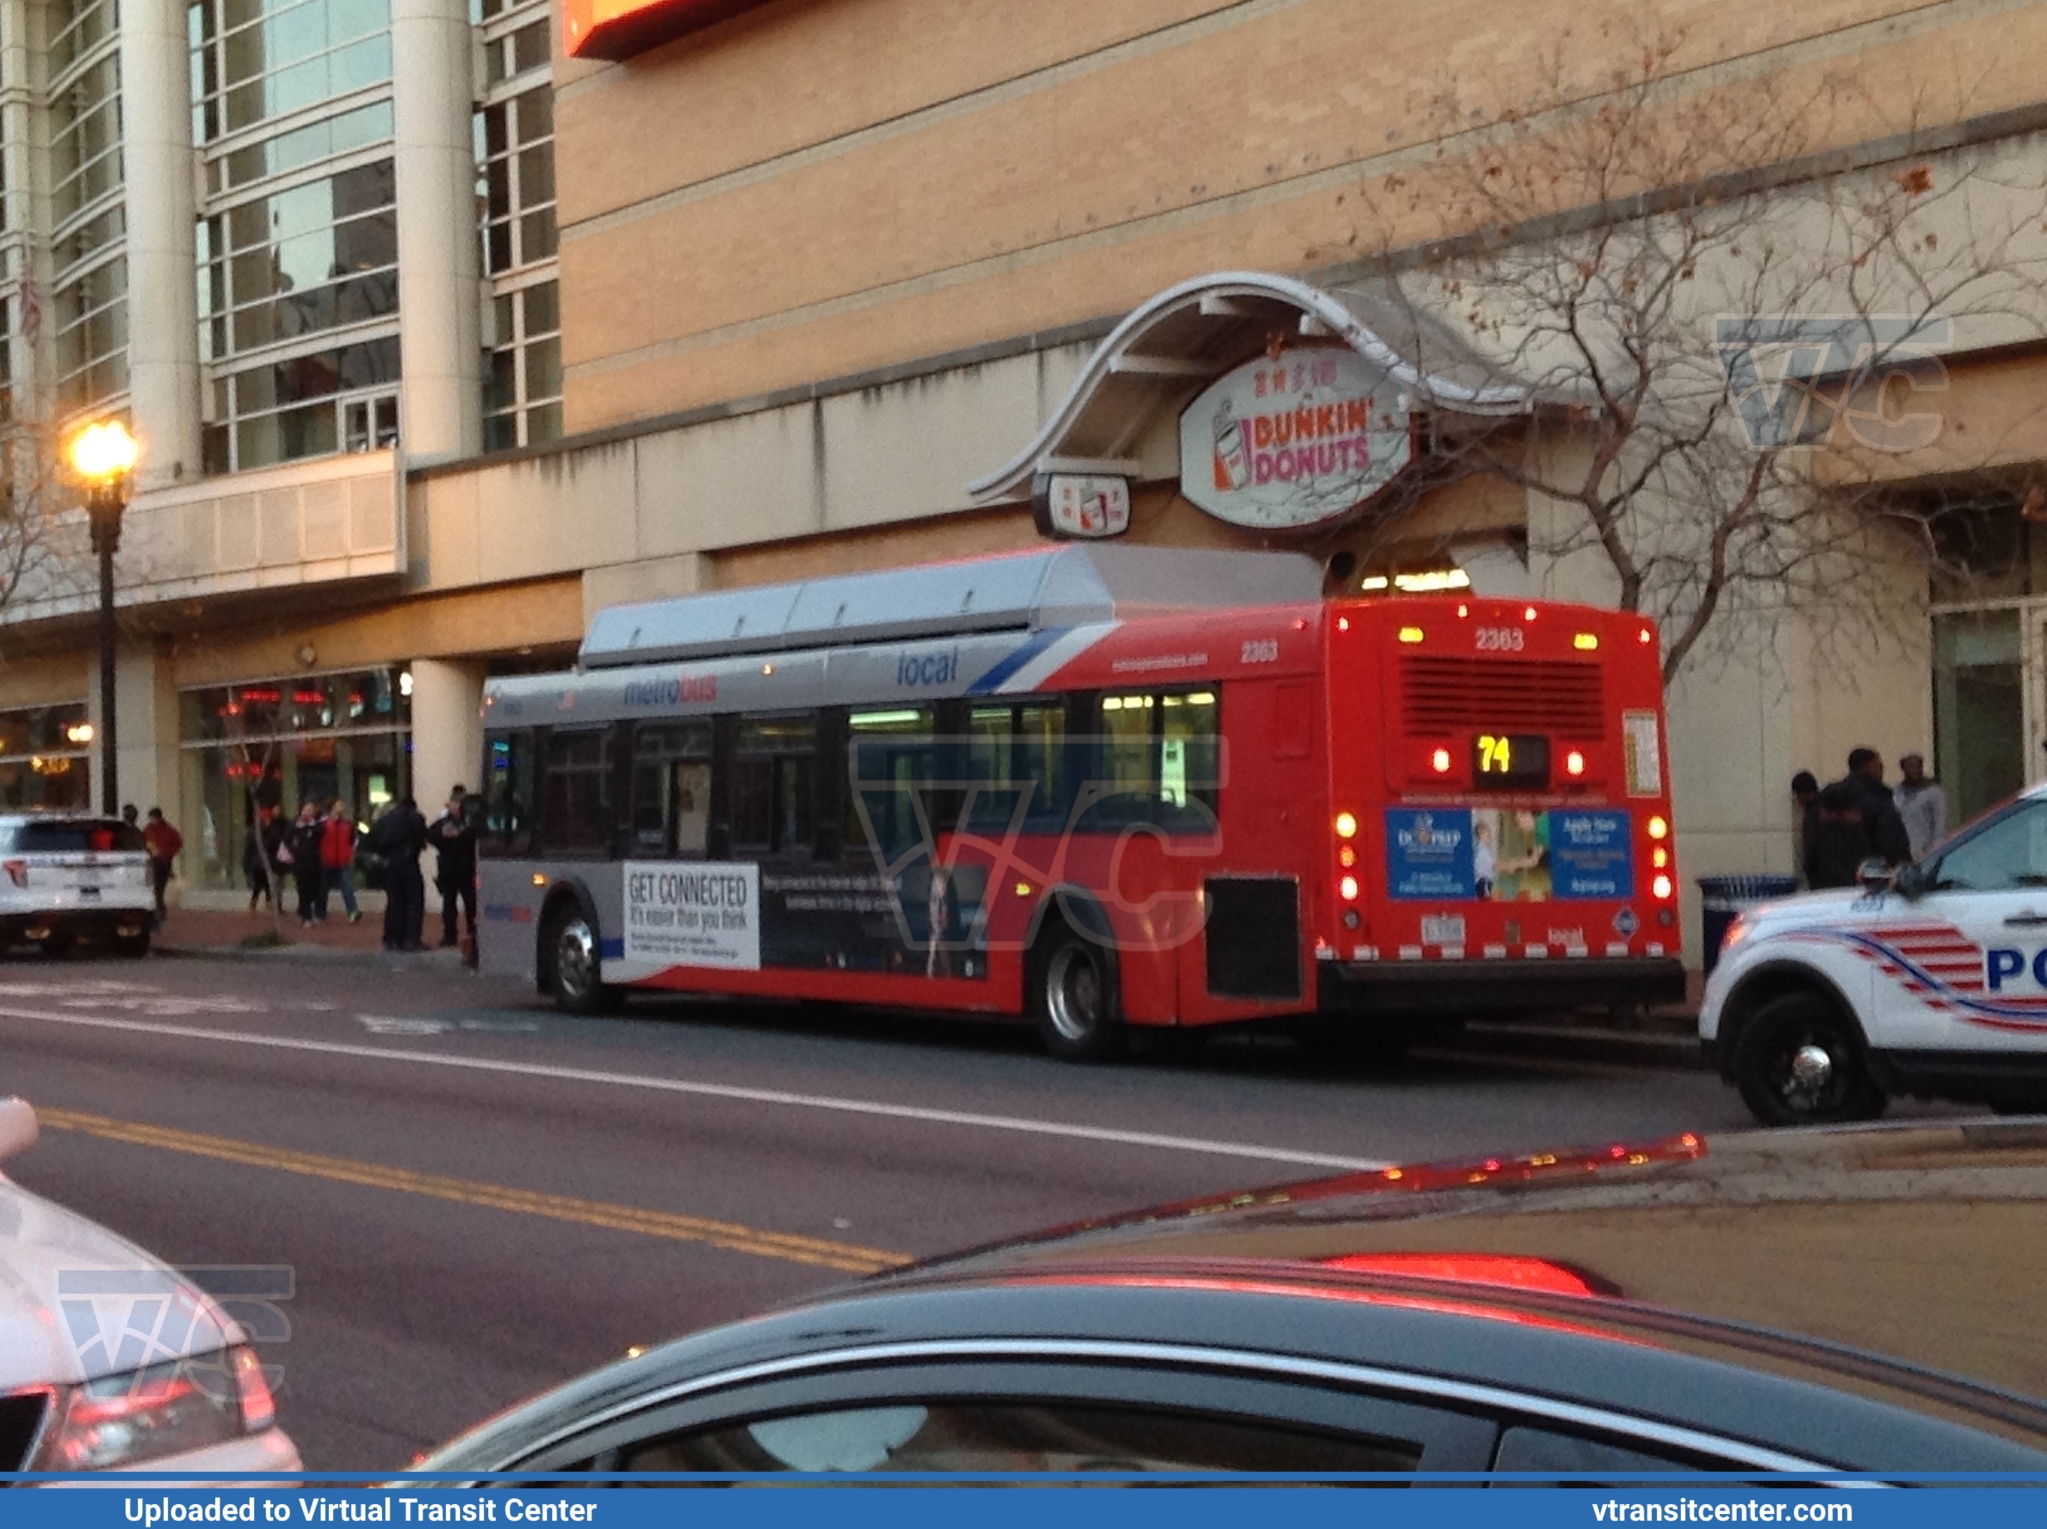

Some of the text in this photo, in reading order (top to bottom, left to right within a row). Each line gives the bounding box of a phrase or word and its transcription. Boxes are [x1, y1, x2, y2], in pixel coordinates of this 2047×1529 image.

[1255, 436, 1371, 485] DONUTS
[1475, 627, 1525, 651] 2363
[896, 646, 959, 686] local
[624, 673, 718, 706] metrobus
[1478, 736, 1510, 773] 74
[630, 873, 654, 903] GET
[660, 873, 748, 908] CONNECTED
[701, 912, 719, 933] you
